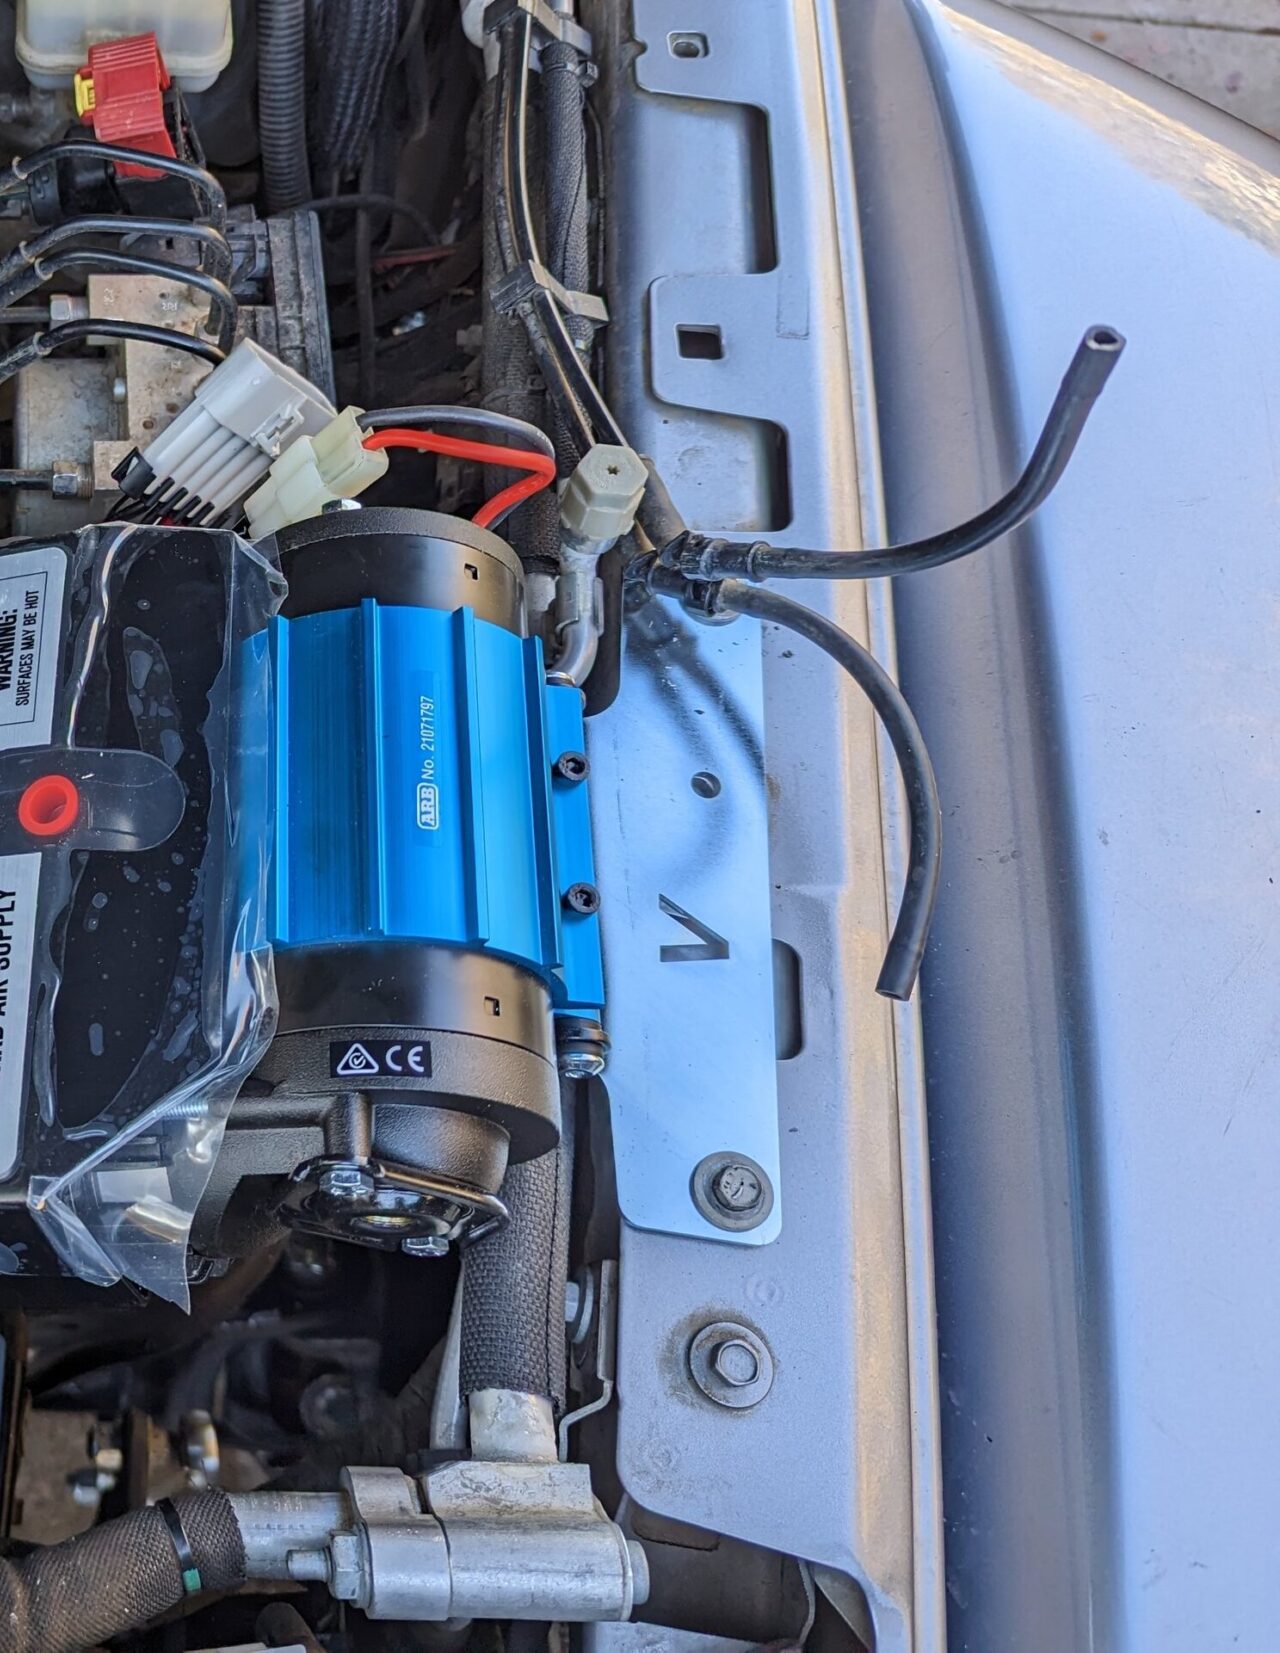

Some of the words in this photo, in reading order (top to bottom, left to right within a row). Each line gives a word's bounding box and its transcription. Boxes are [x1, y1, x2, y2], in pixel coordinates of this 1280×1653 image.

[24, 590, 40, 611] HOT
[23, 612, 38, 627] BE
[20, 629, 36, 652] MAY
[15, 653, 34, 706] SURFACES
[420, 695, 435, 751] 21071797
[421, 756, 435, 780] No.
[419, 786, 436, 827] ARB
